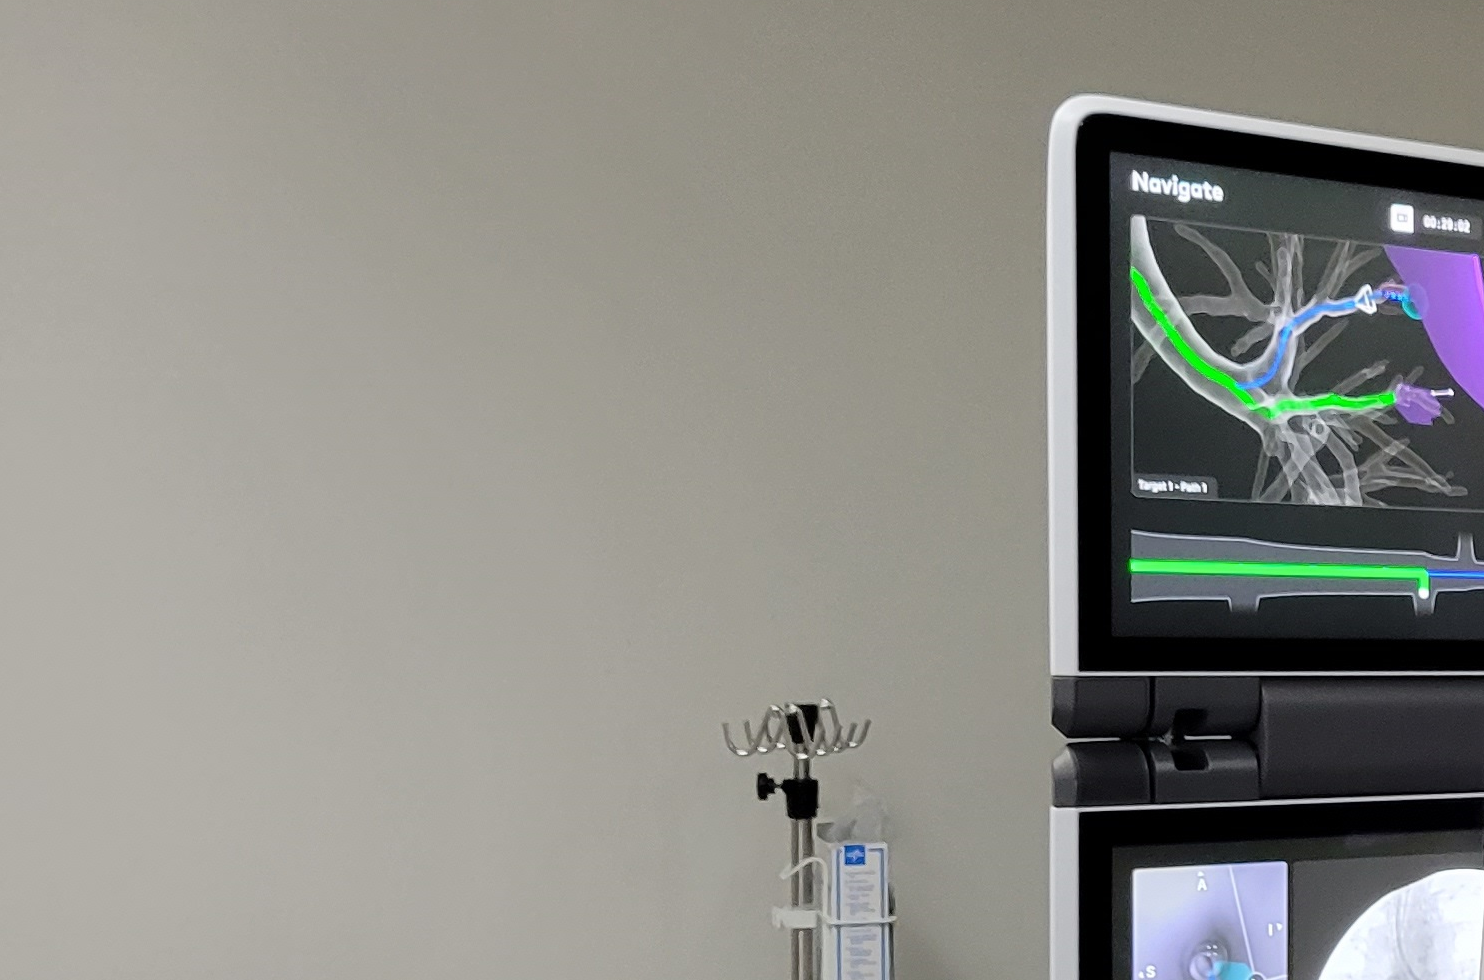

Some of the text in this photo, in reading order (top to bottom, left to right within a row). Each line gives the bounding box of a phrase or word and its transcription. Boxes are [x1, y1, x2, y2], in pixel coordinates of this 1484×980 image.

[1131, 170, 1224, 203] Navigate
[1197, 878, 1208, 892] A
[1145, 965, 1157, 979] S
